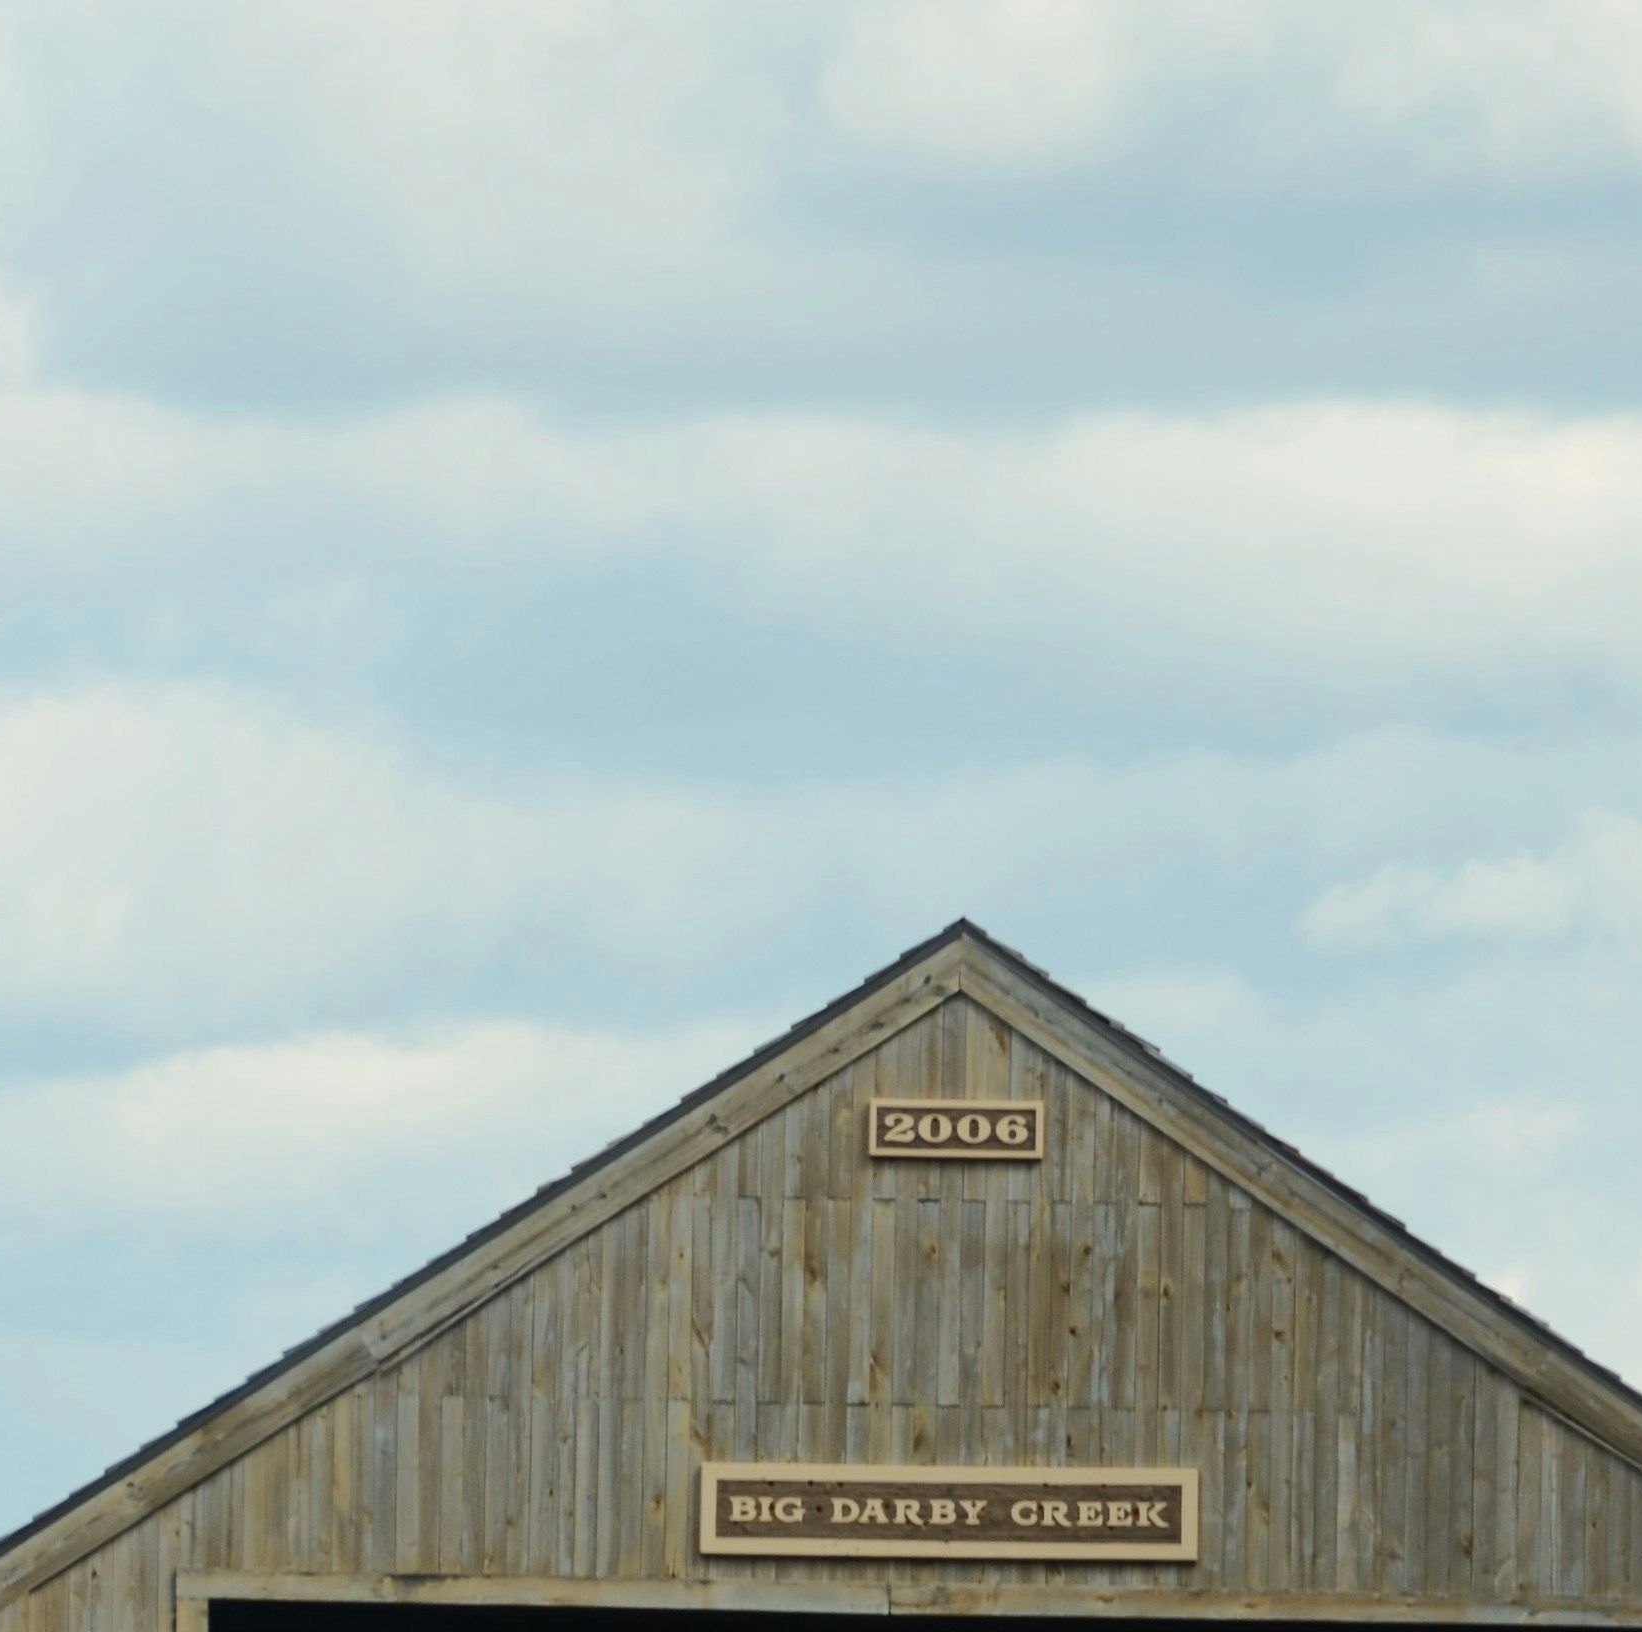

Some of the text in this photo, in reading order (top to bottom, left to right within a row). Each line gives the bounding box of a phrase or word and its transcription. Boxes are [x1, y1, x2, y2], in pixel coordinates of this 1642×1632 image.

[883, 1112, 1029, 1145] 2006
[728, 1495, 1170, 1529] BIG DARBY CREEK
